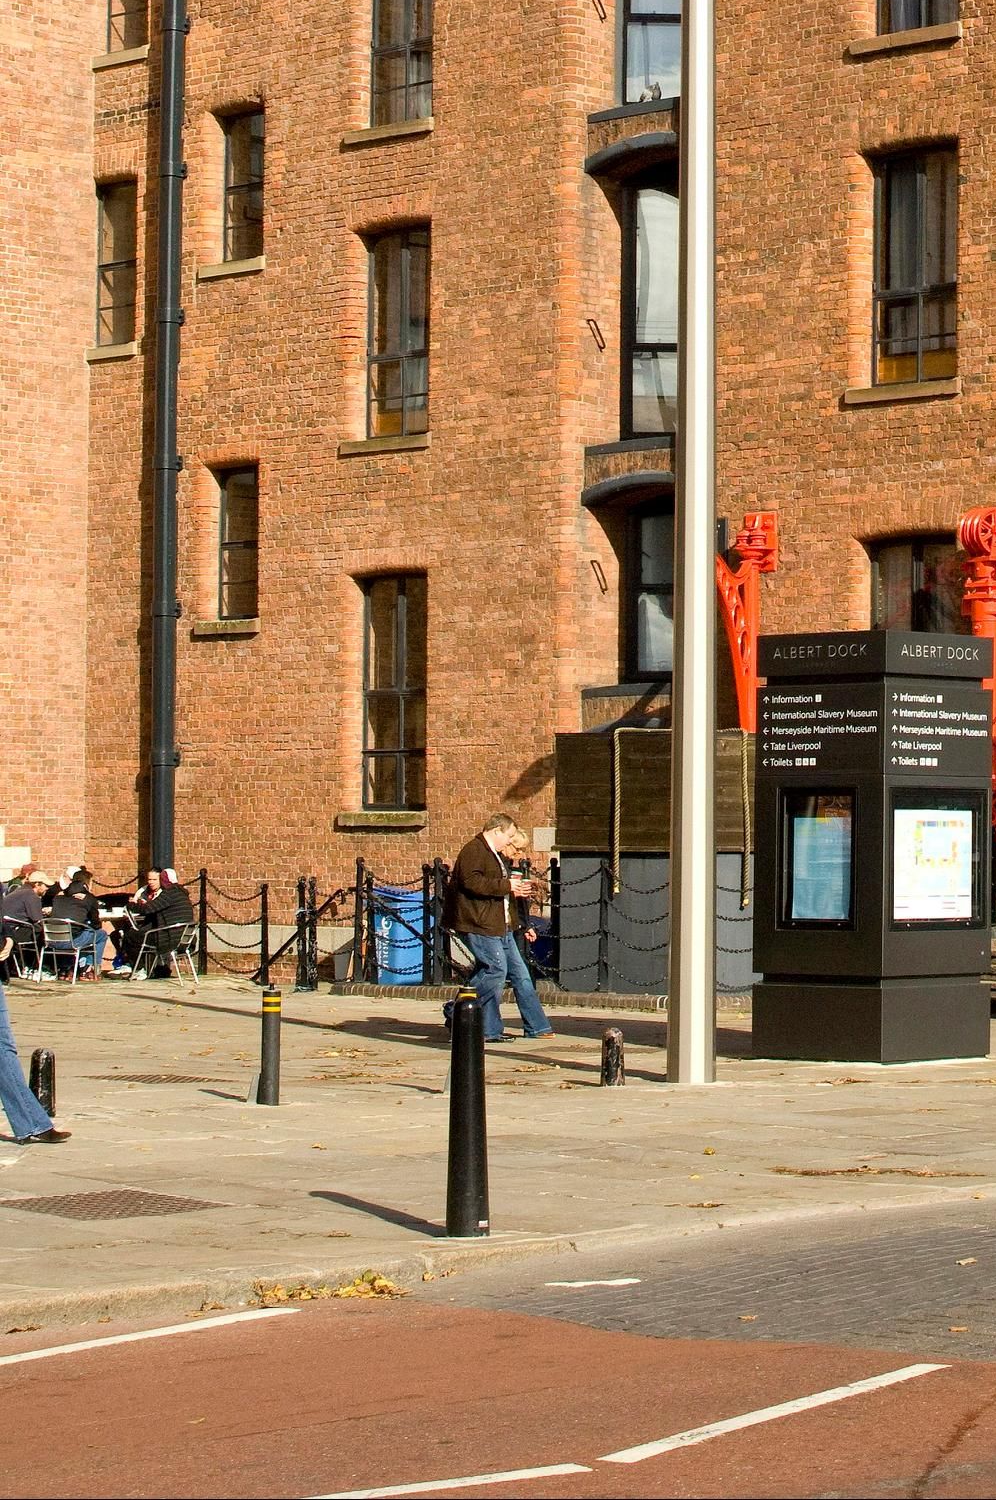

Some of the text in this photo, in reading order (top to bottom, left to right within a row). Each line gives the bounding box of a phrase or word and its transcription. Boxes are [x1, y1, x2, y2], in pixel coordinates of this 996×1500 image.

[773, 643, 868, 660] ALBERT DOCK
[901, 644, 980, 661] ALBERT DOCK
[771, 694, 813, 704] Information
[900, 693, 935, 703] Information
[771, 709, 878, 720] International Slavery Museum
[899, 708, 988, 721] International Slavery Museum
[771, 725, 878, 736] Merseyside Maritime Museum
[899, 725, 988, 737] Merseyside Maritime Museum
[770, 741, 822, 752] Tate Liverpool
[898, 740, 942, 751] Tate Liverpool
[770, 758, 793, 767] Toilets
[898, 756, 918, 766] Toilets
